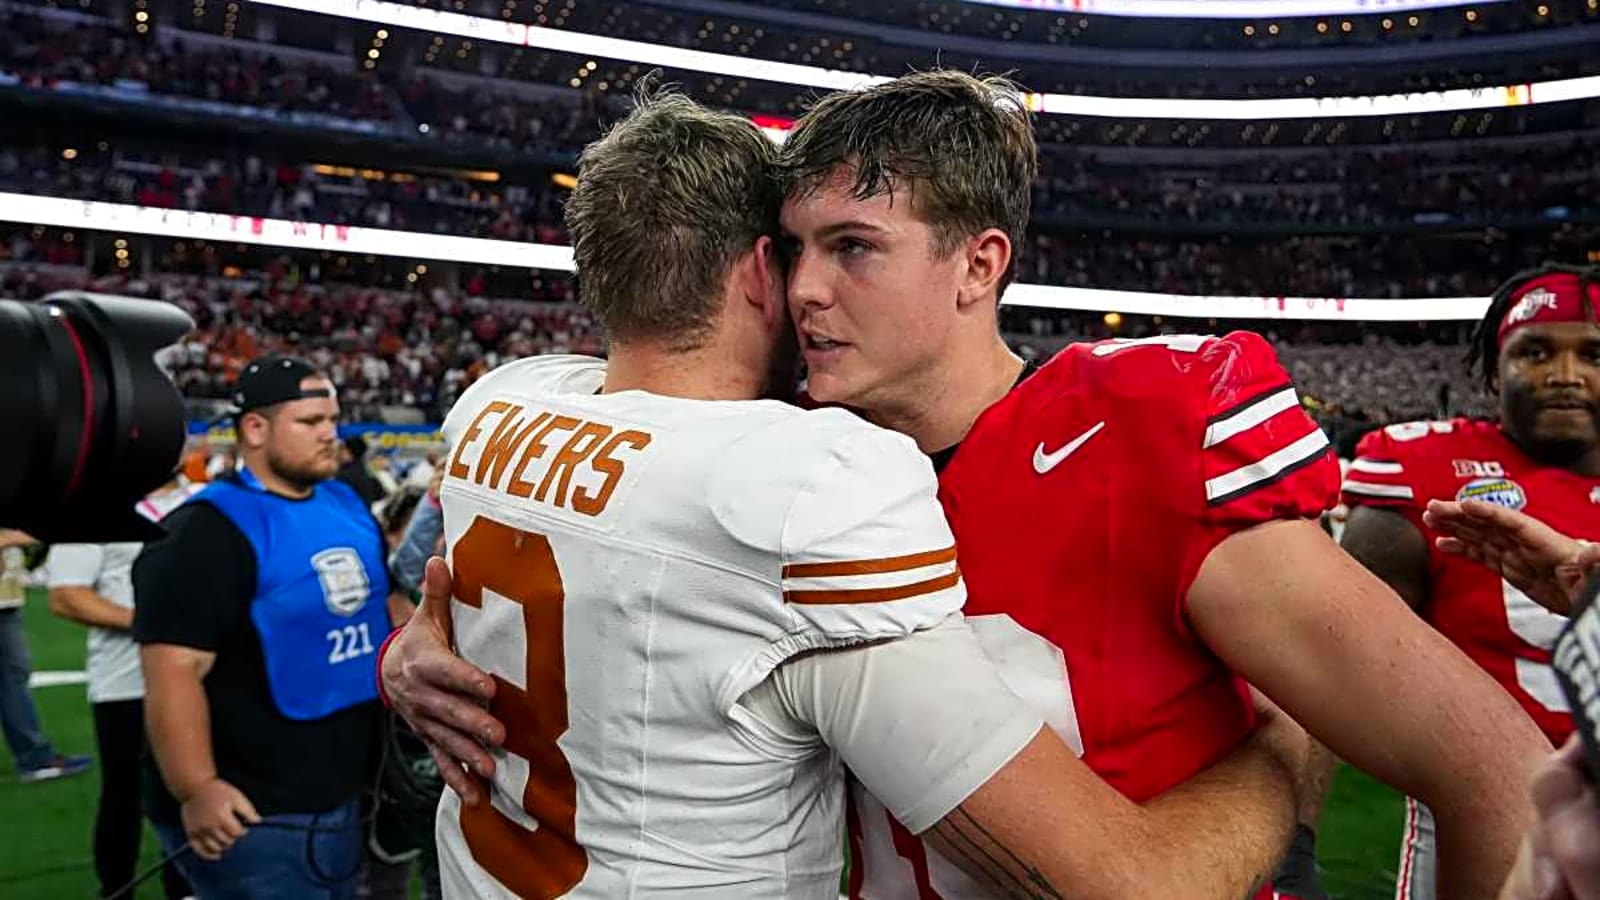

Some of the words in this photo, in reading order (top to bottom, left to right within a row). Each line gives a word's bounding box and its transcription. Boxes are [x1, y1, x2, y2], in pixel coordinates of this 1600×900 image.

[449, 400, 652, 517] EWERS
[326, 622, 375, 665] 221
[452, 514, 589, 899] 3
